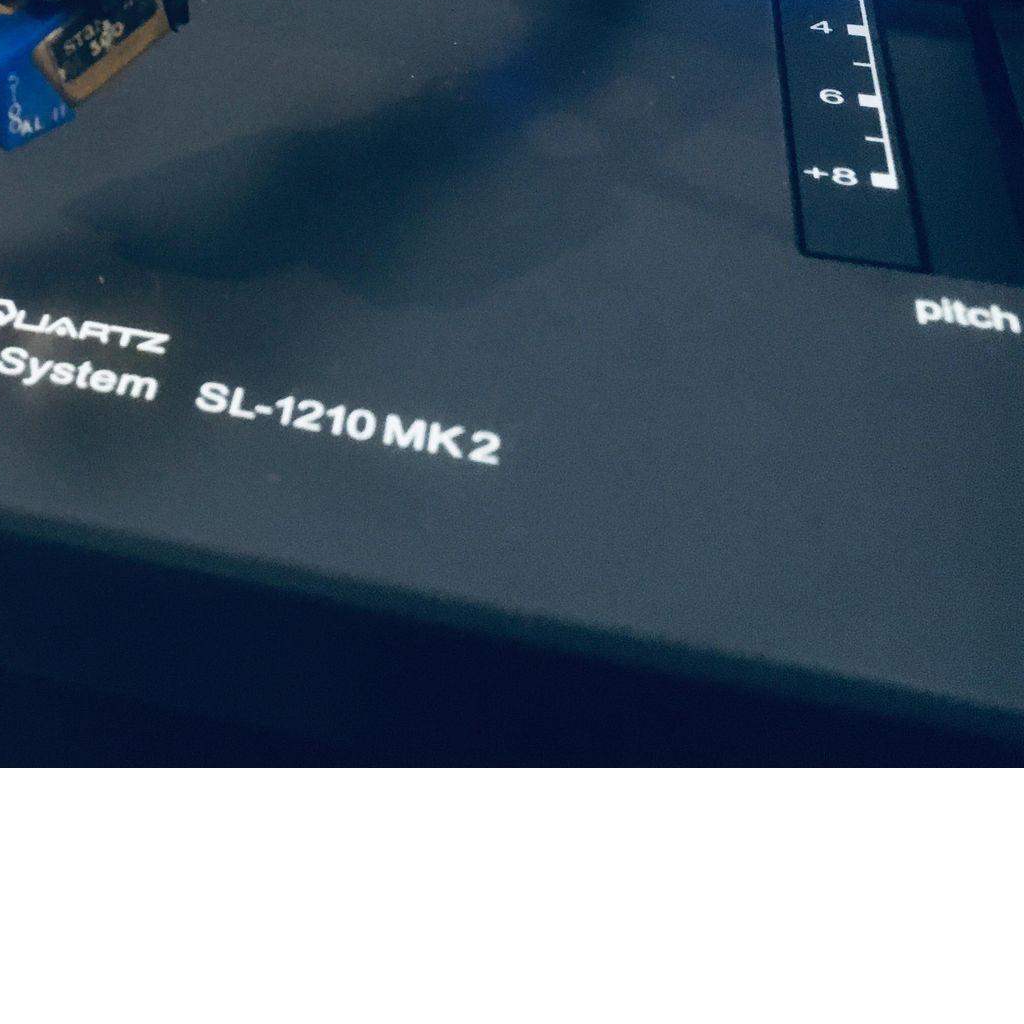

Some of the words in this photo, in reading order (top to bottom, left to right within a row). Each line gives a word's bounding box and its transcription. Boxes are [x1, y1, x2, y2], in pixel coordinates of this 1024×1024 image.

[809, 20, 834, 35] 4
[819, 88, 845, 105] 6
[803, 166, 859, 187] +8
[914, 296, 1023, 335] pitch
[194, 380, 378, 442] SL-1210
